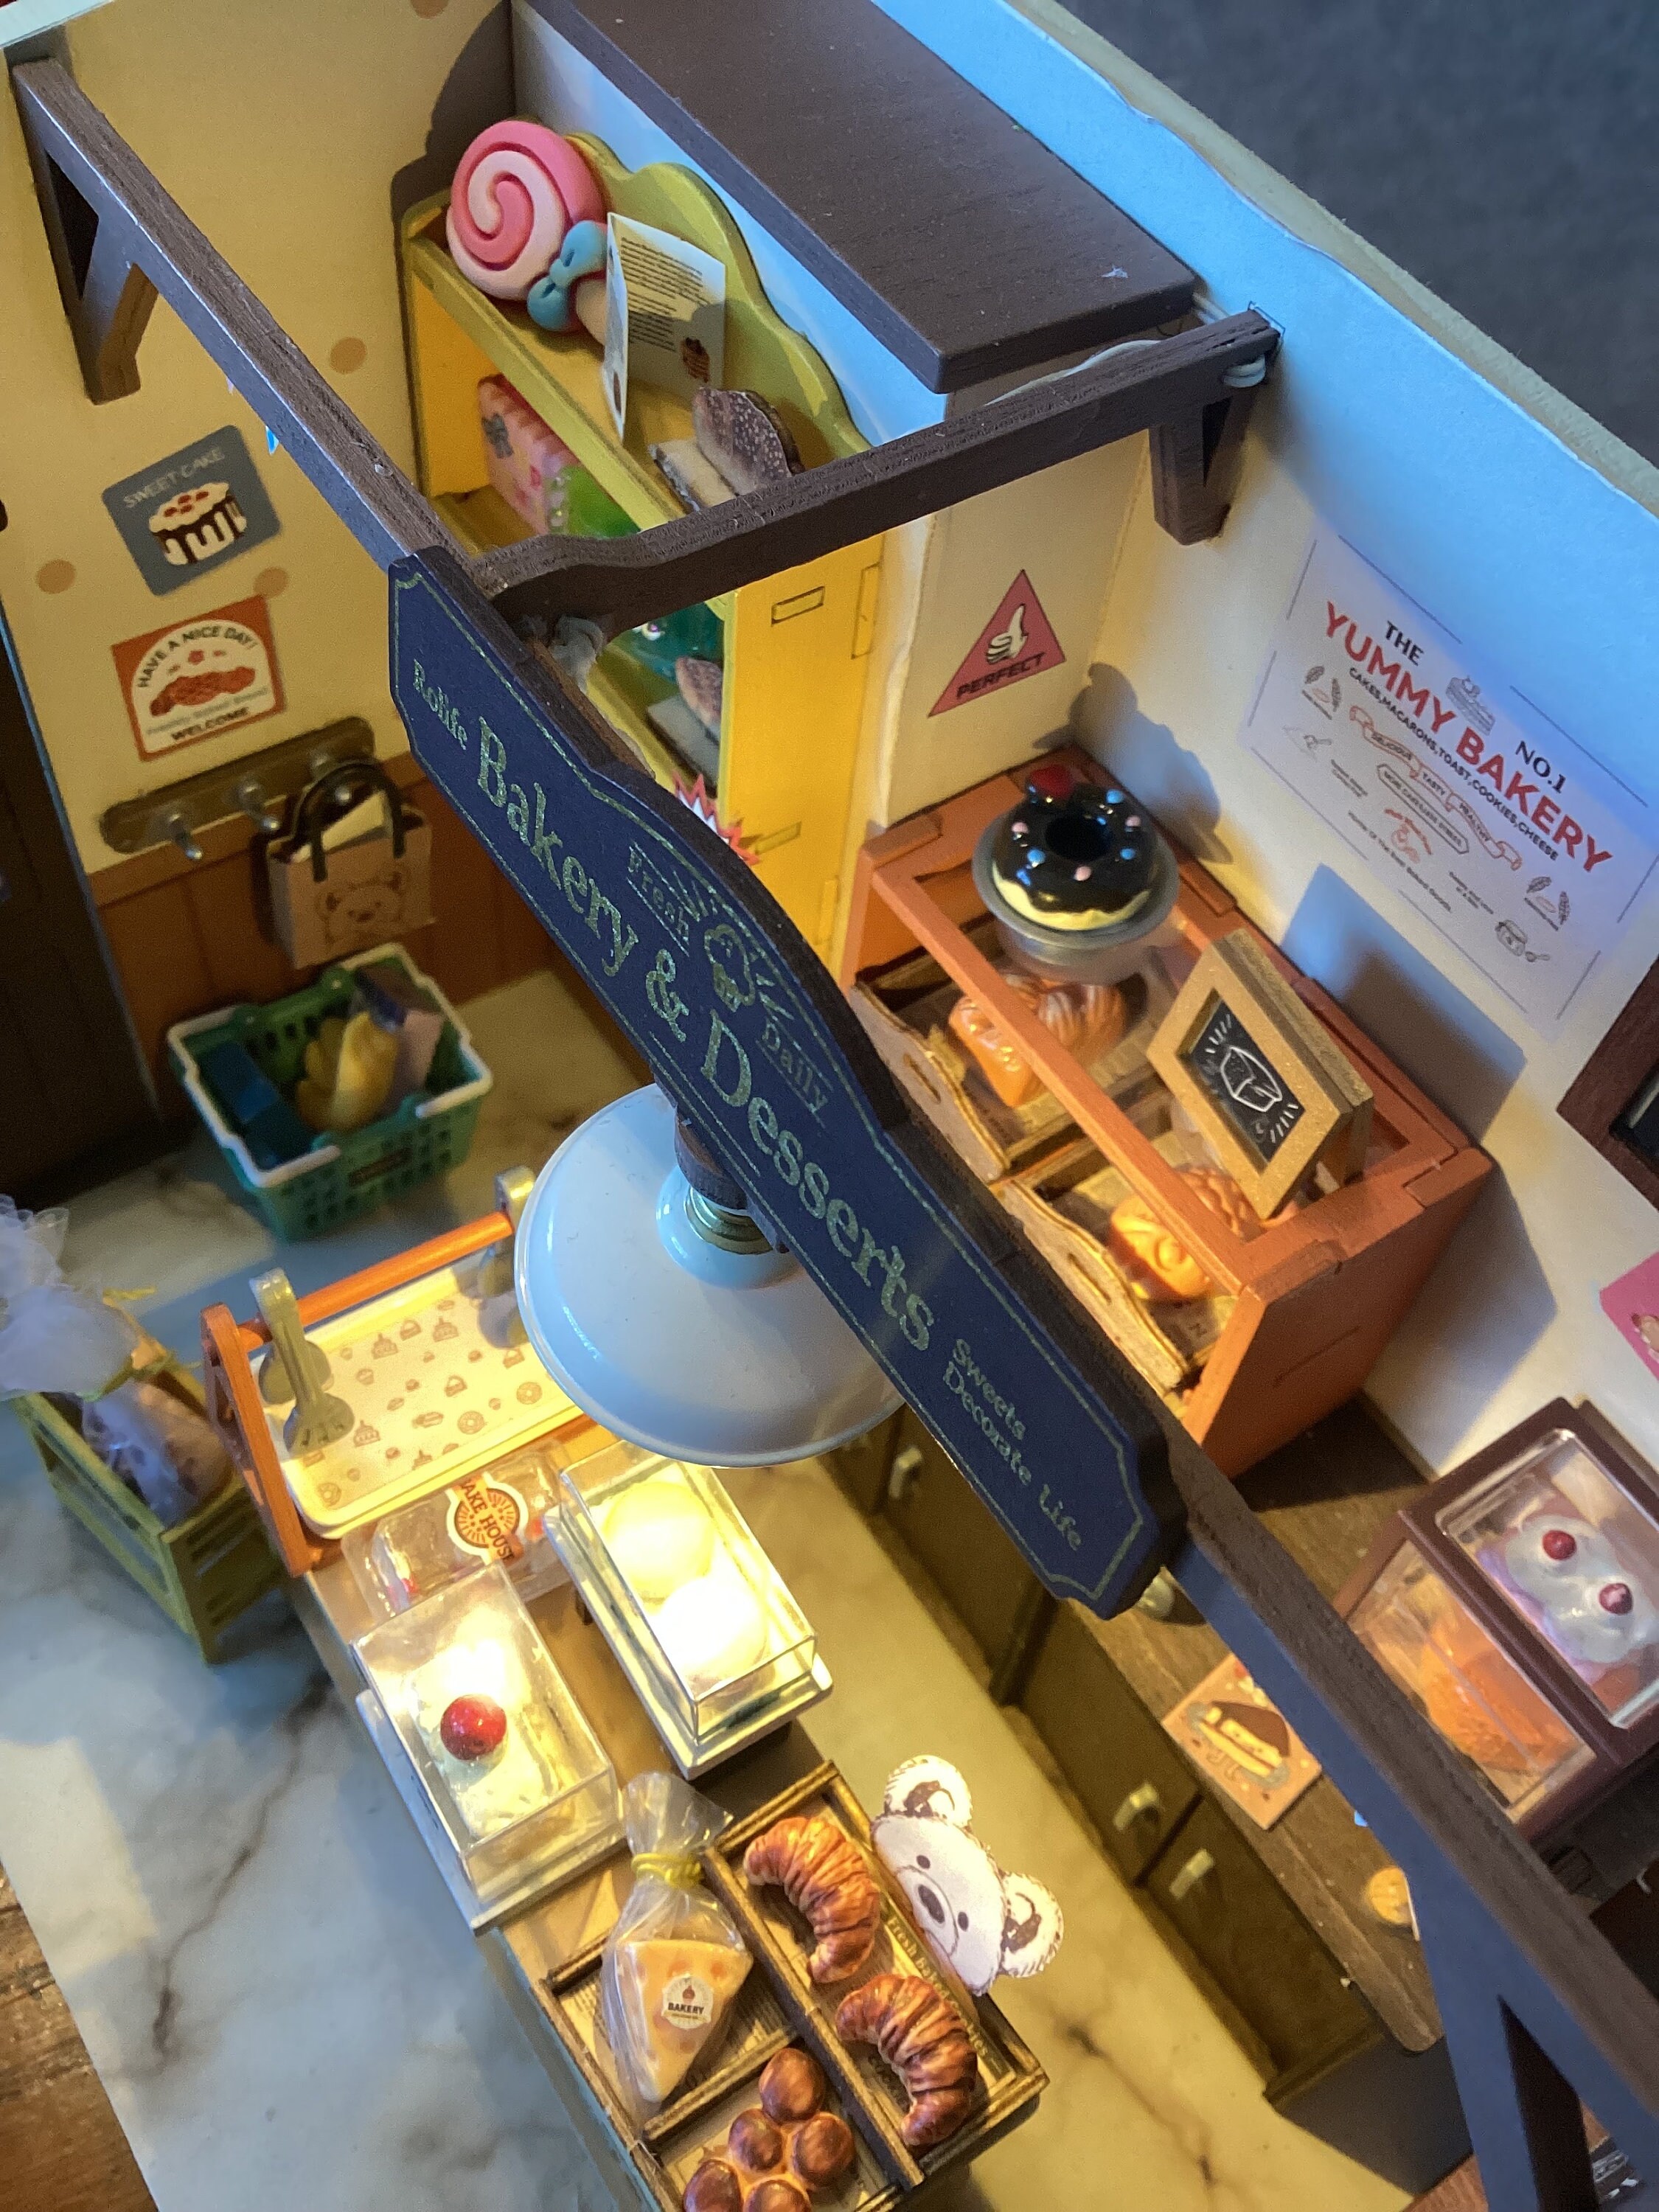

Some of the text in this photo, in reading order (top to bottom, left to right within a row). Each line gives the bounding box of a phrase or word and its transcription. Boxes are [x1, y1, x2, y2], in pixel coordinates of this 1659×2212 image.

[137, 650, 167, 688] HAVE
[168, 641, 181, 652] A
[182, 626, 221, 643] NICE
[1385, 620, 1425, 667] THE
[414, 658, 468, 751] Rolife
[956, 652, 1046, 700] PERFECT
[1326, 601, 1457, 734] YUMMY
[1455, 726, 1613, 873] BAKERY
[1515, 740, 1567, 794] NO.1
[1422, 773, 1446, 796] TASTY
[628, 846, 690, 945] Fresh
[477, 716, 934, 1351] Bakery & Desserts
[762, 1019, 828, 1113] Daily
[953, 1338, 1026, 1440] Sweets
[943, 1360, 1082, 1551] Decorate Life
[461, 1479, 487, 1514] AKE
[887, 1917, 917, 1957] Fresh
[667, 2001, 705, 2015] BAKERY
